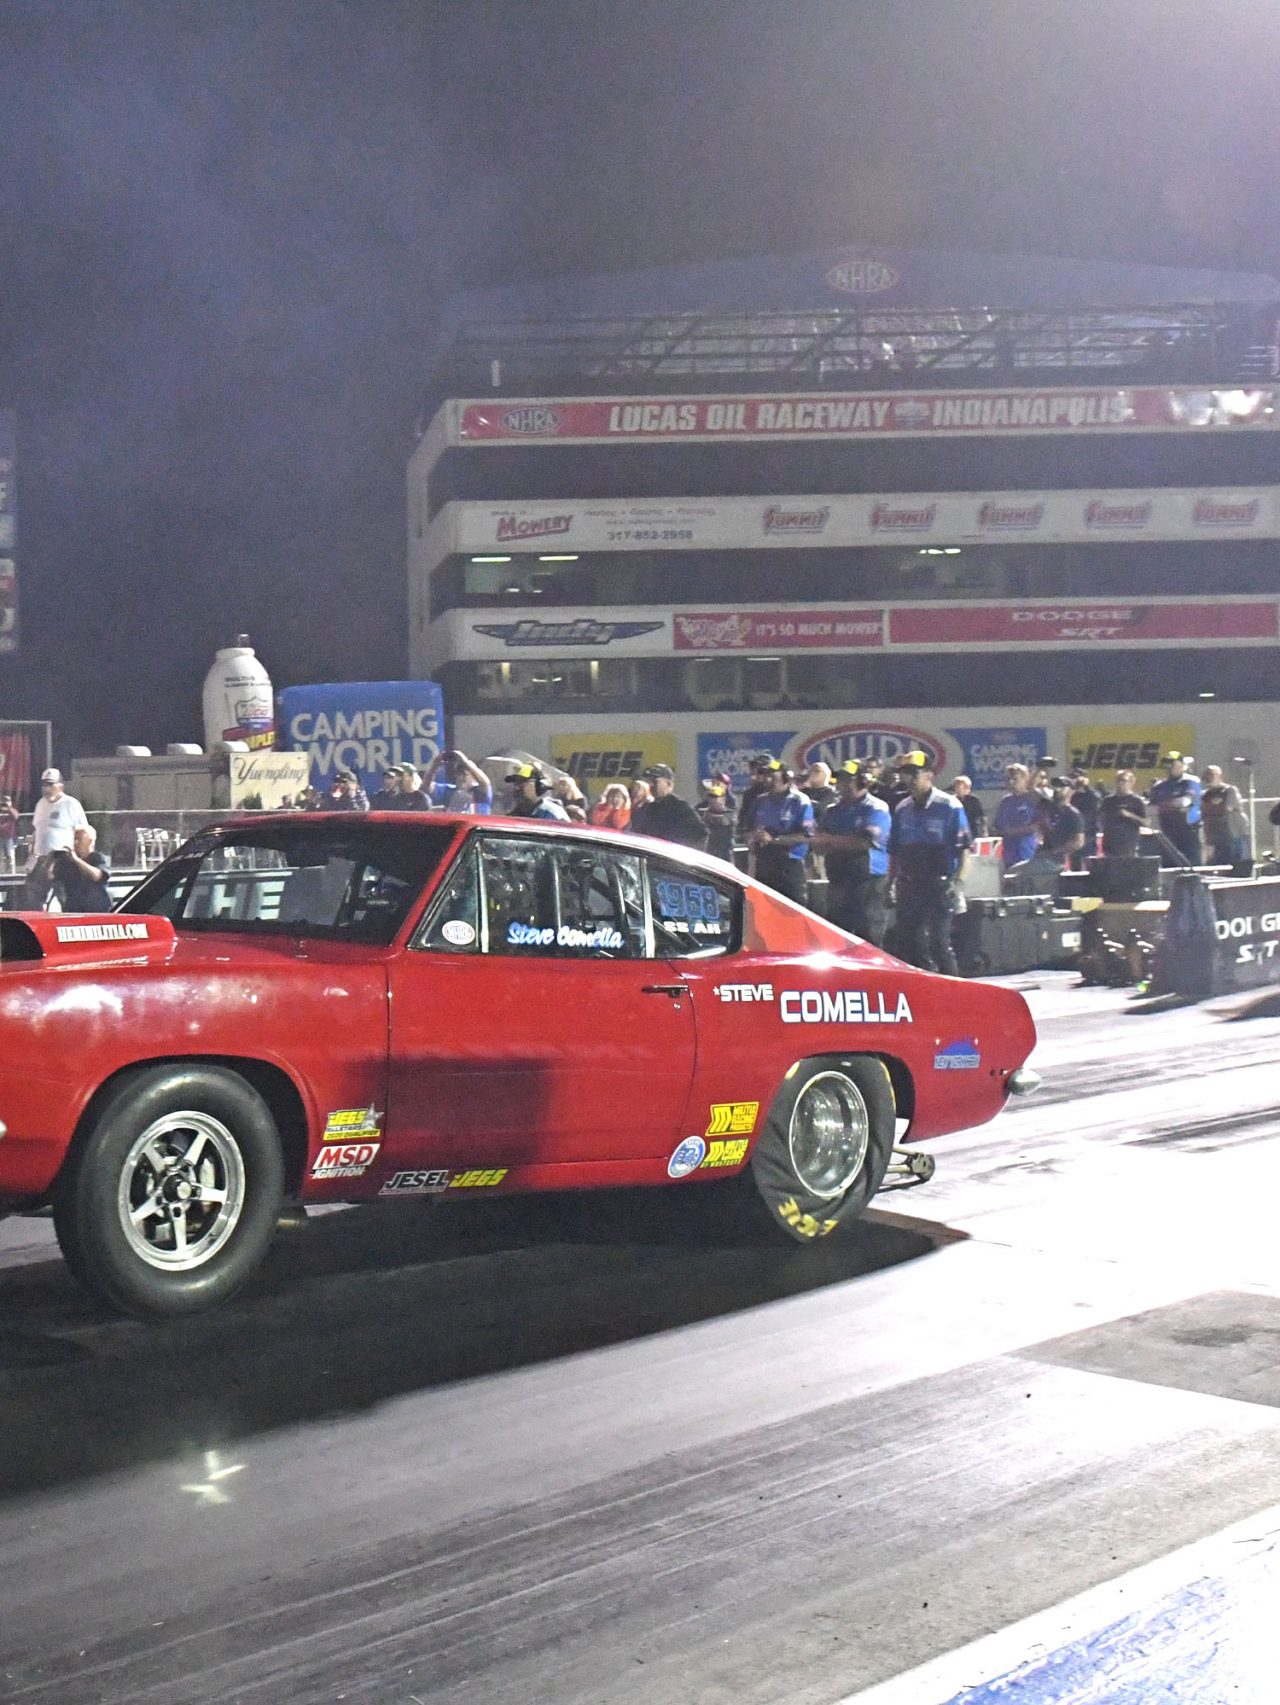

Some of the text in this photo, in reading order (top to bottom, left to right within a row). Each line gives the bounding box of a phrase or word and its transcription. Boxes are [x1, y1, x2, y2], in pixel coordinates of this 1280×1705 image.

[609, 404, 697, 432] LUCAS
[705, 404, 748, 431] OIL
[757, 401, 893, 430] RACEWAY
[932, 396, 1130, 427] INDIANAPOLIS
[1011, 609, 1133, 621] DODGE
[290, 709, 439, 742] CAMPING
[294, 738, 440, 776] WORLD
[567, 750, 643, 779] JEGS
[1073, 742, 1161, 770] JEGS
[231, 757, 305, 786] Yuengling
[507, 921, 624, 949] Steve Comella
[694, 920, 721, 934] AH
[719, 984, 914, 1024] STEVE COMELLA
[327, 1110, 367, 1127] JEGS
[319, 1145, 374, 1168] MSD
[312, 1166, 366, 1179] IGNITION
[386, 1170, 449, 1189] JESEL
[449, 1168, 509, 1188] JEGS
